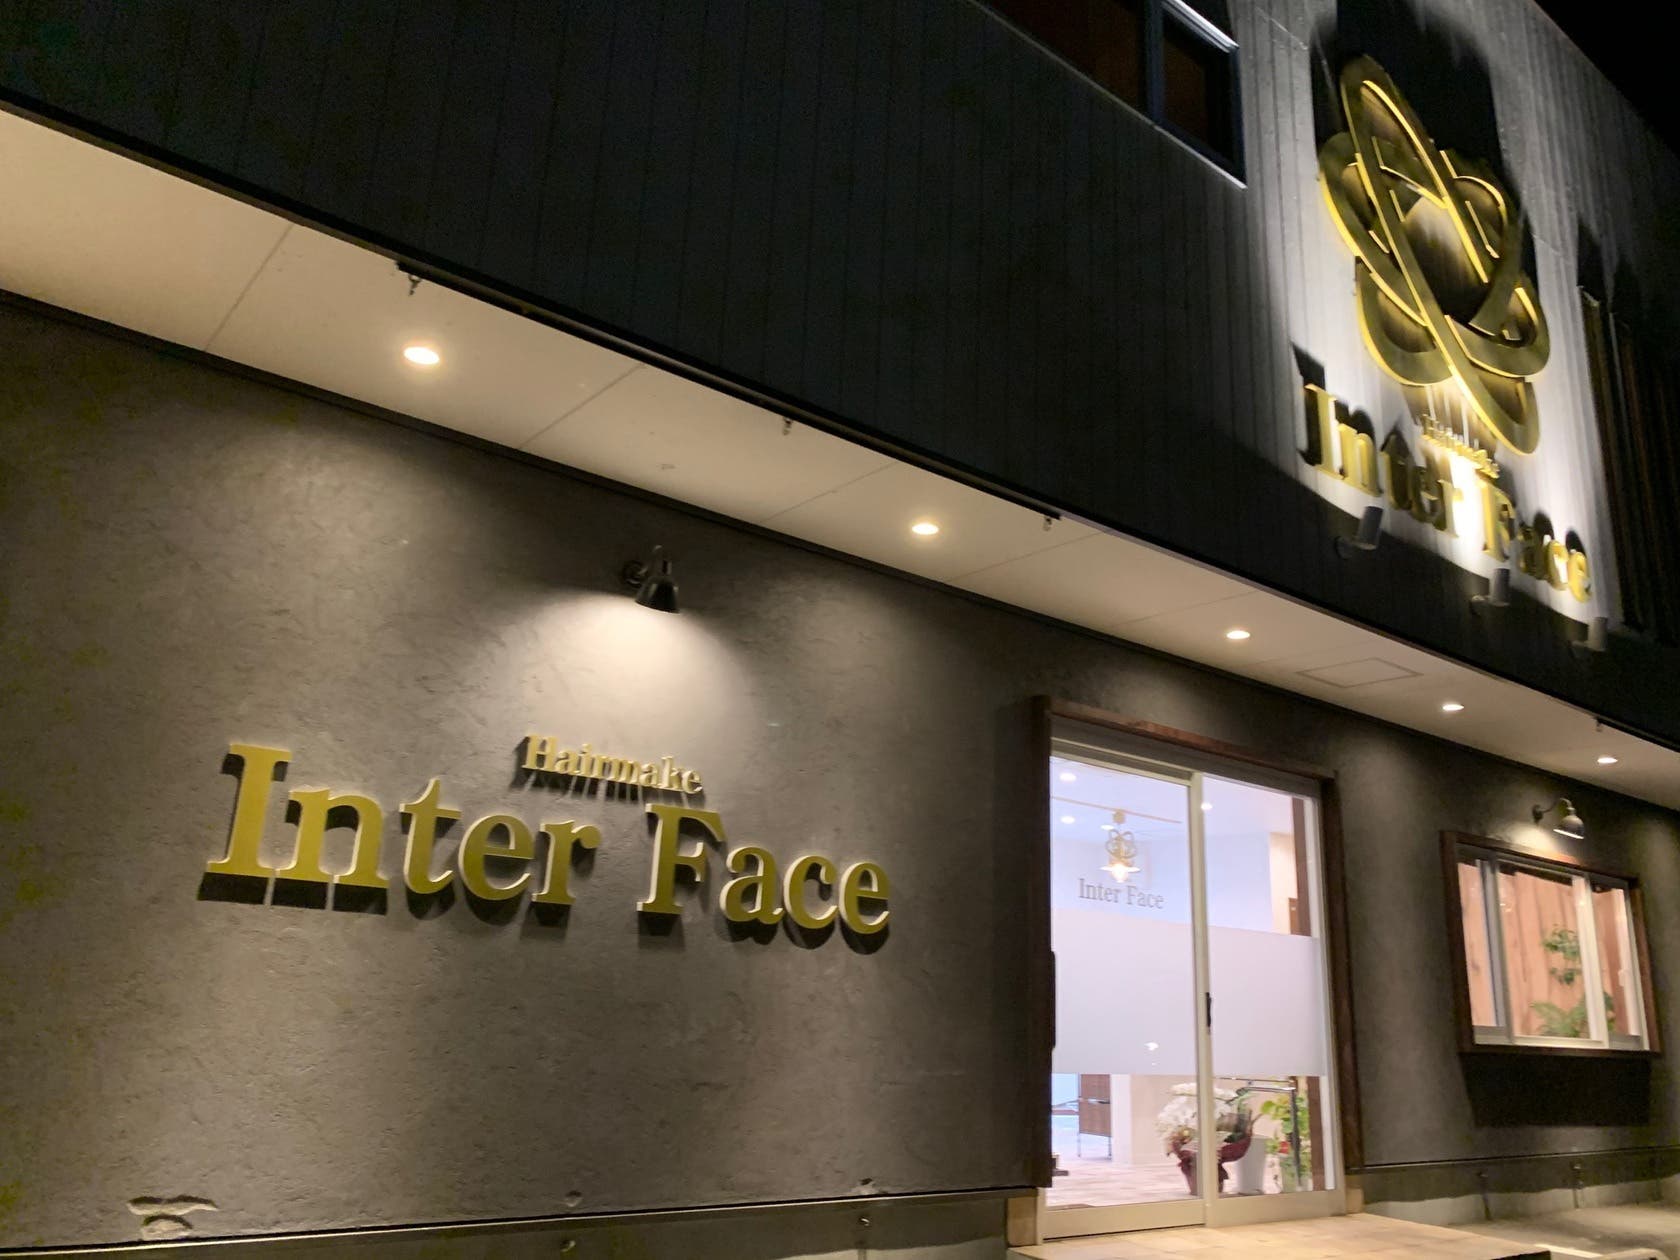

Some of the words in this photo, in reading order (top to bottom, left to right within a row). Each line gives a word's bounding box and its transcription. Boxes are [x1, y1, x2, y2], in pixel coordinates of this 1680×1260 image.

[521, 734, 703, 795] Hairmake
[207, 743, 601, 906] Inter
[636, 803, 890, 934] Face
[1078, 878, 1121, 903] Inter
[1126, 885, 1164, 909] Face
